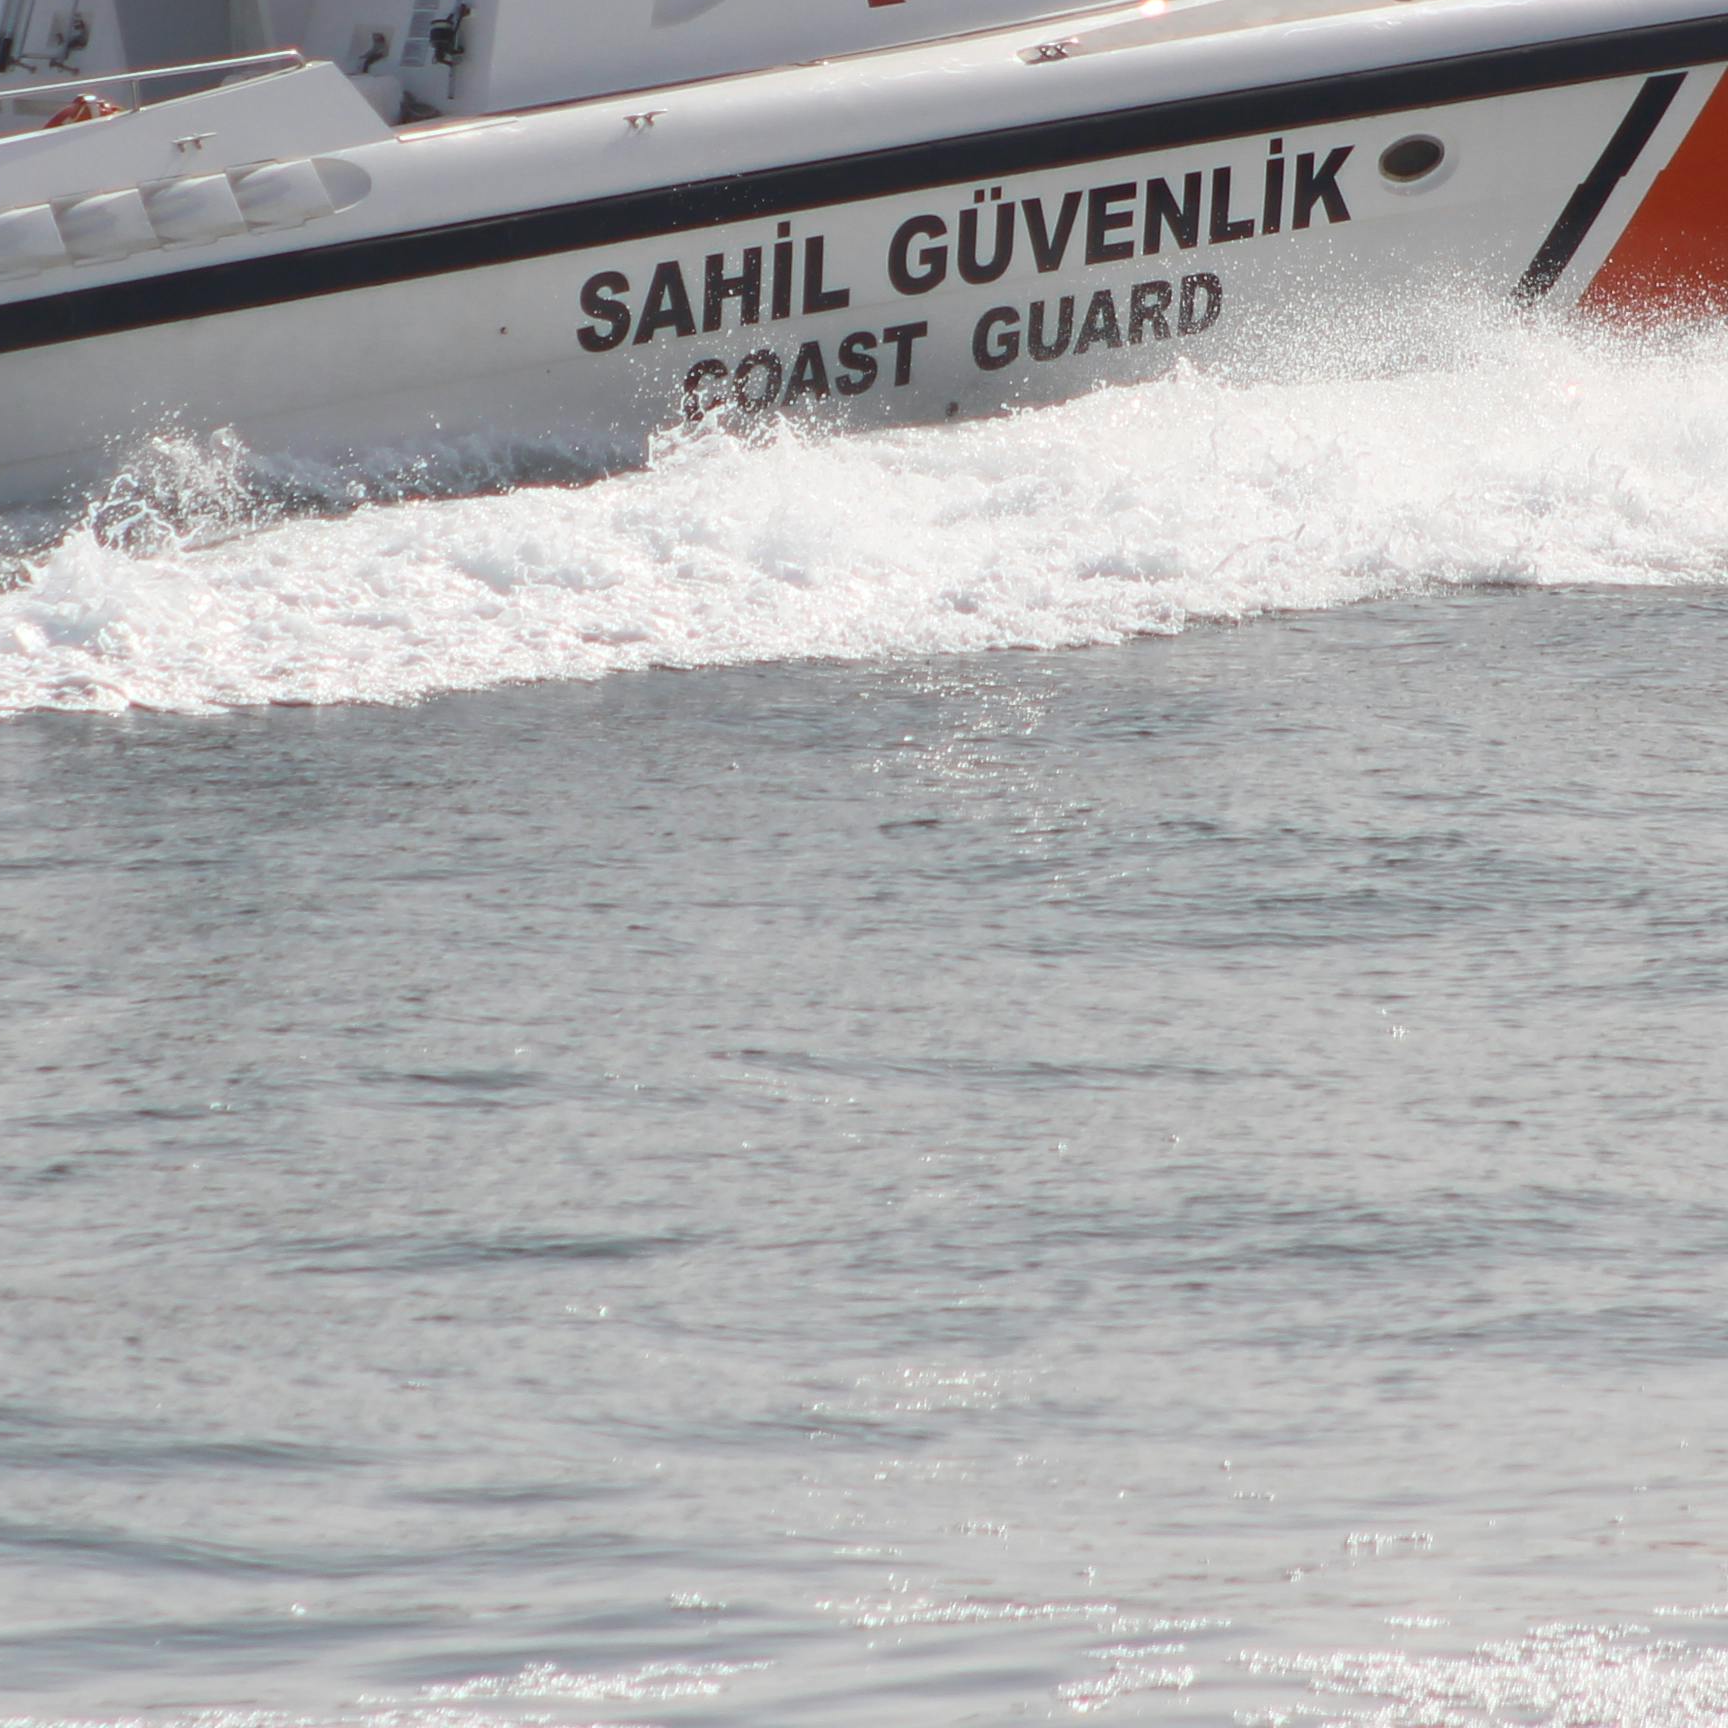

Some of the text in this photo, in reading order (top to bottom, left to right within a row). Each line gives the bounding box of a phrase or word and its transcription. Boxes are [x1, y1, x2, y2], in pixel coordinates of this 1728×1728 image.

[575, 137, 1355, 353] SAHİL GÜVENLİK
[683, 272, 1223, 421] COAST GUARD
